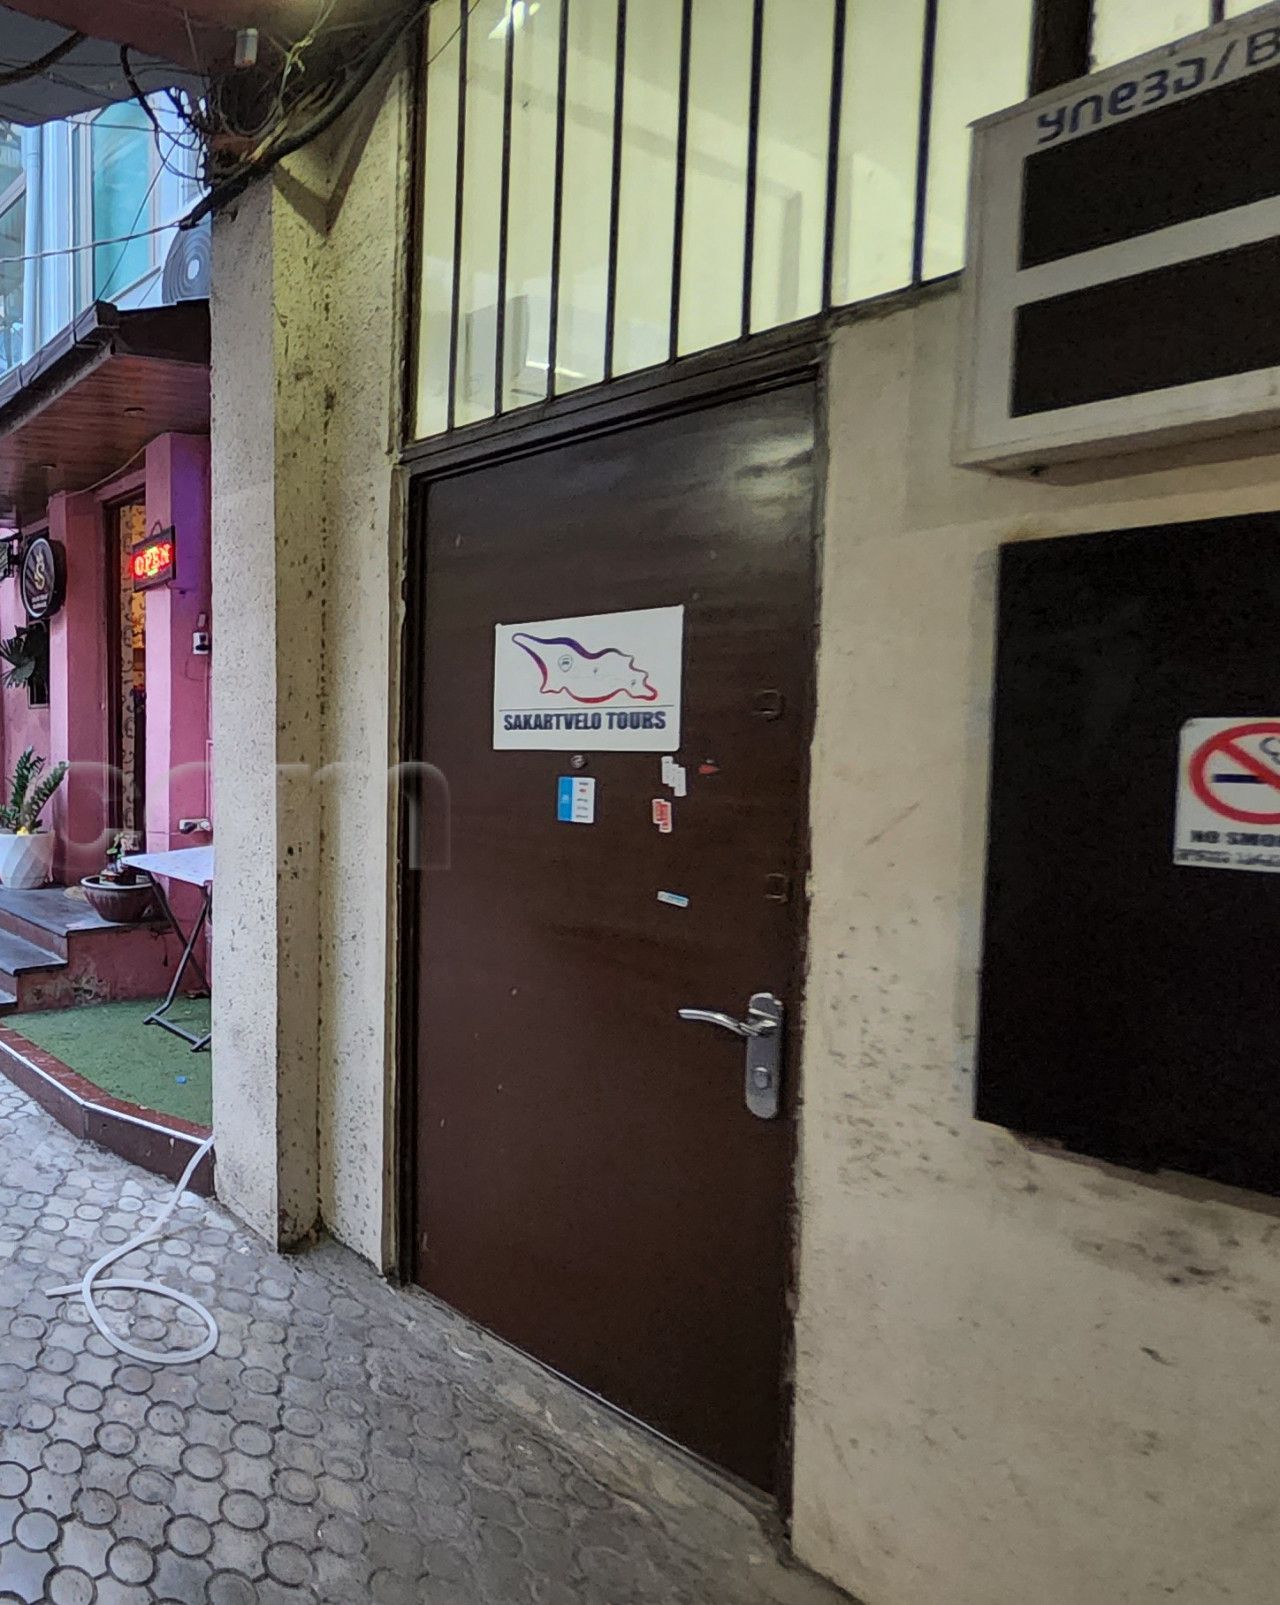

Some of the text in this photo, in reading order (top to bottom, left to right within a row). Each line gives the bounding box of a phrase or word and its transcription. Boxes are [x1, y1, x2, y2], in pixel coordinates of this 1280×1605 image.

[134, 543, 171, 577] OPEN
[503, 710, 667, 731] SAKARTVELO TOURS
